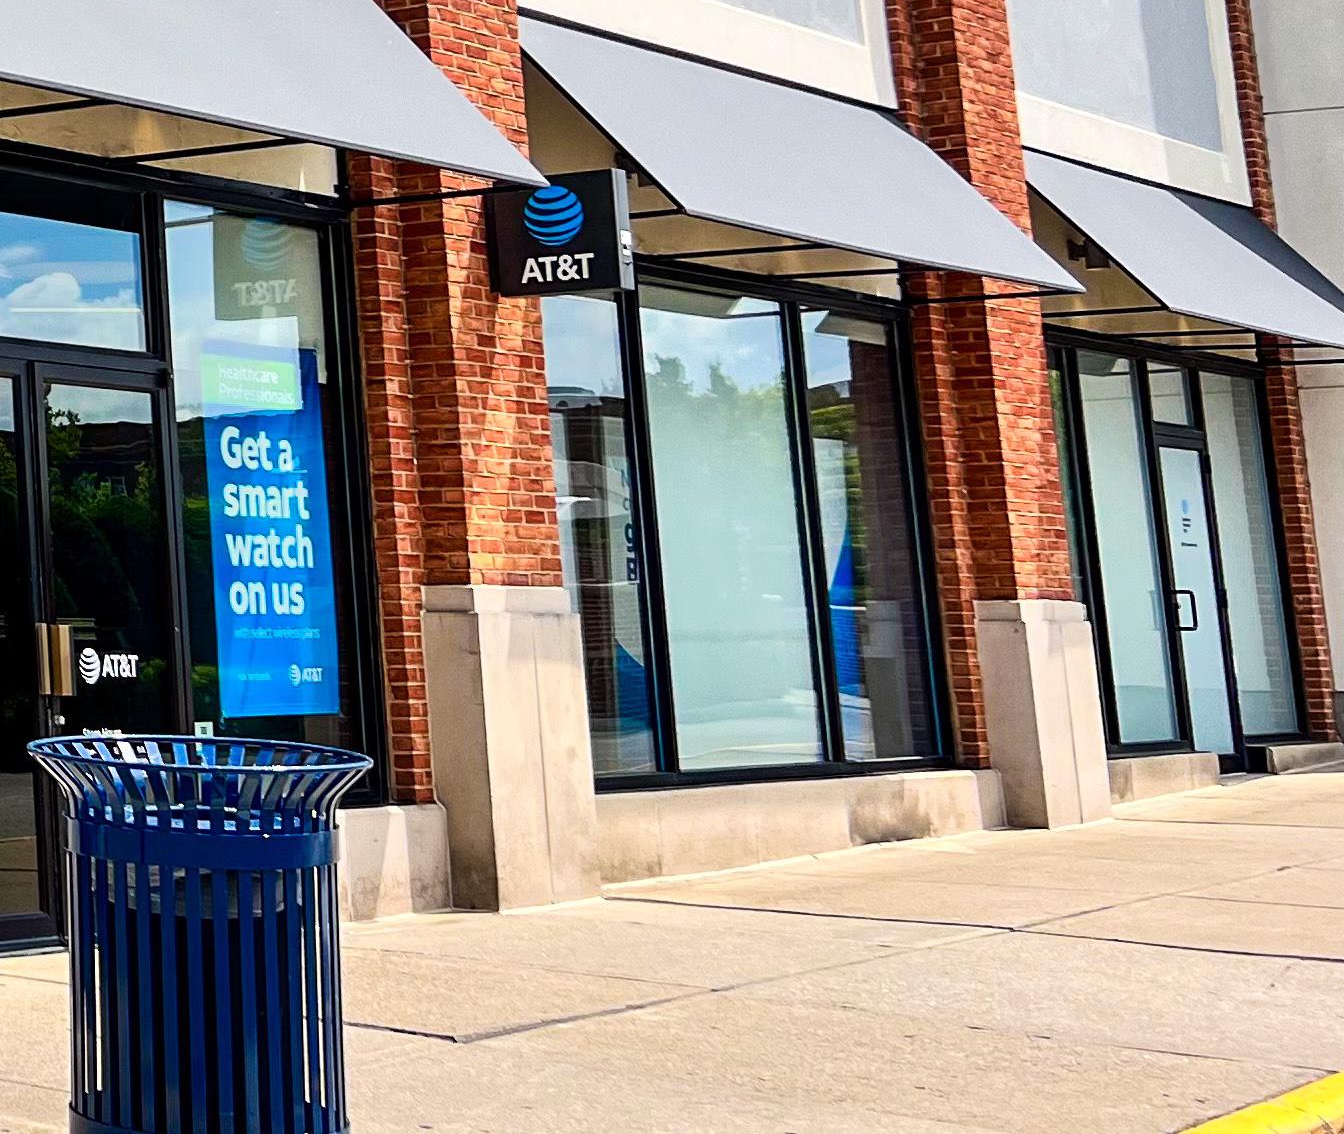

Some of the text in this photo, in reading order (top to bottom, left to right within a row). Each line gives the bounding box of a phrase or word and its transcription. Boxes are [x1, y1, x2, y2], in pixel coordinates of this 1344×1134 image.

[521, 253, 594, 284] AT&T
[219, 364, 279, 384] Healthcare
[219, 383, 294, 405] Professionals
[220, 426, 294, 471] Get a
[223, 480, 310, 520] smart
[225, 524, 314, 569] watch
[229, 581, 305, 615] on us
[102, 654, 139, 677] AT&T
[302, 667, 322, 682] AT&T
